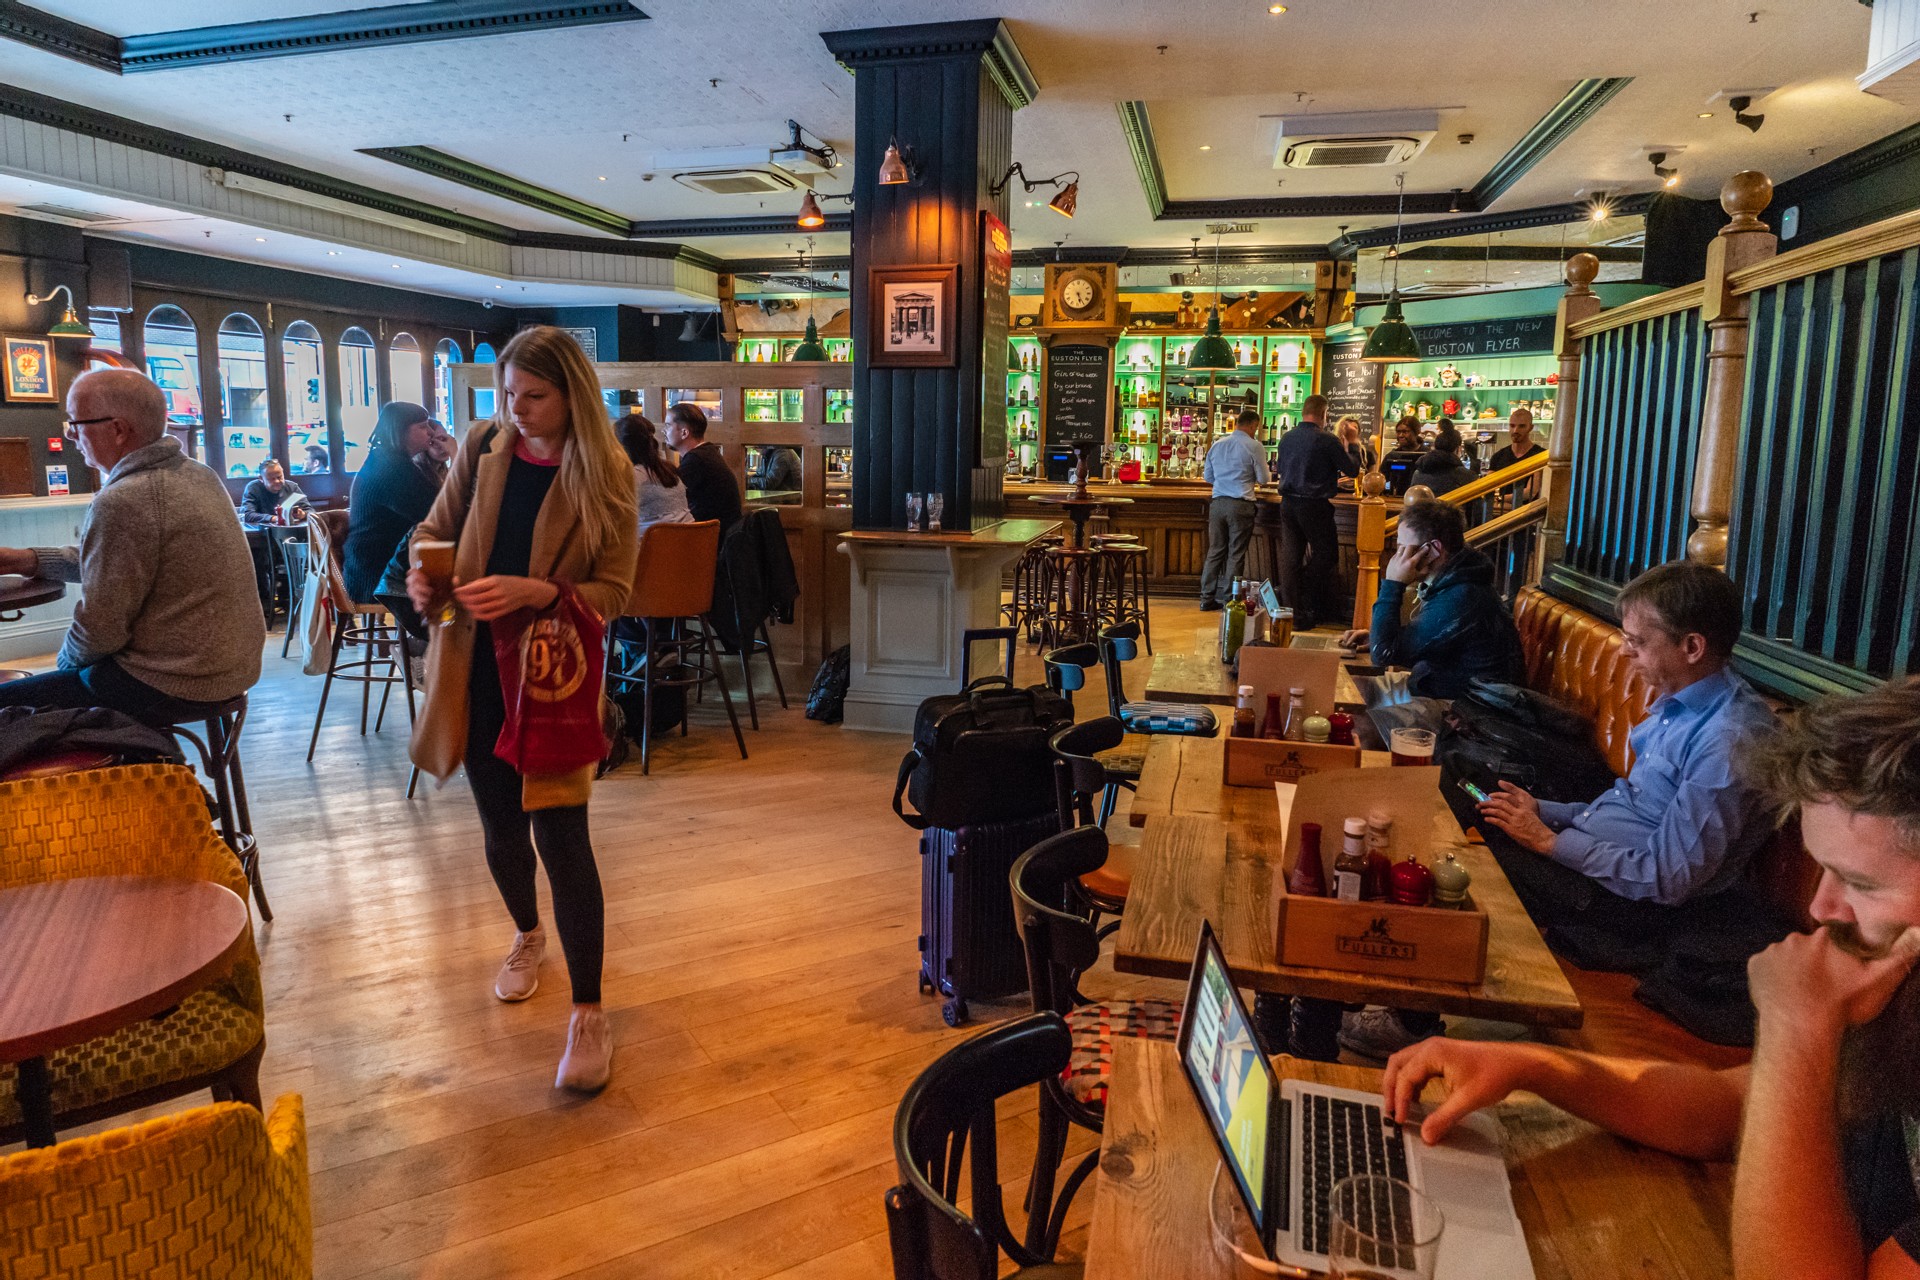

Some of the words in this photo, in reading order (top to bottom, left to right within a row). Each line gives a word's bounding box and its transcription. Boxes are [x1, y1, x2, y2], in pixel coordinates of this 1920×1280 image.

[1463, 326, 1475, 336] TO
[1485, 325, 1504, 335] THE
[1515, 321, 1542, 332] NEW
[1428, 341, 1475, 356] EUSTON
[1486, 337, 1521, 351] FLYER
[15, 375, 45, 383] LONDON
